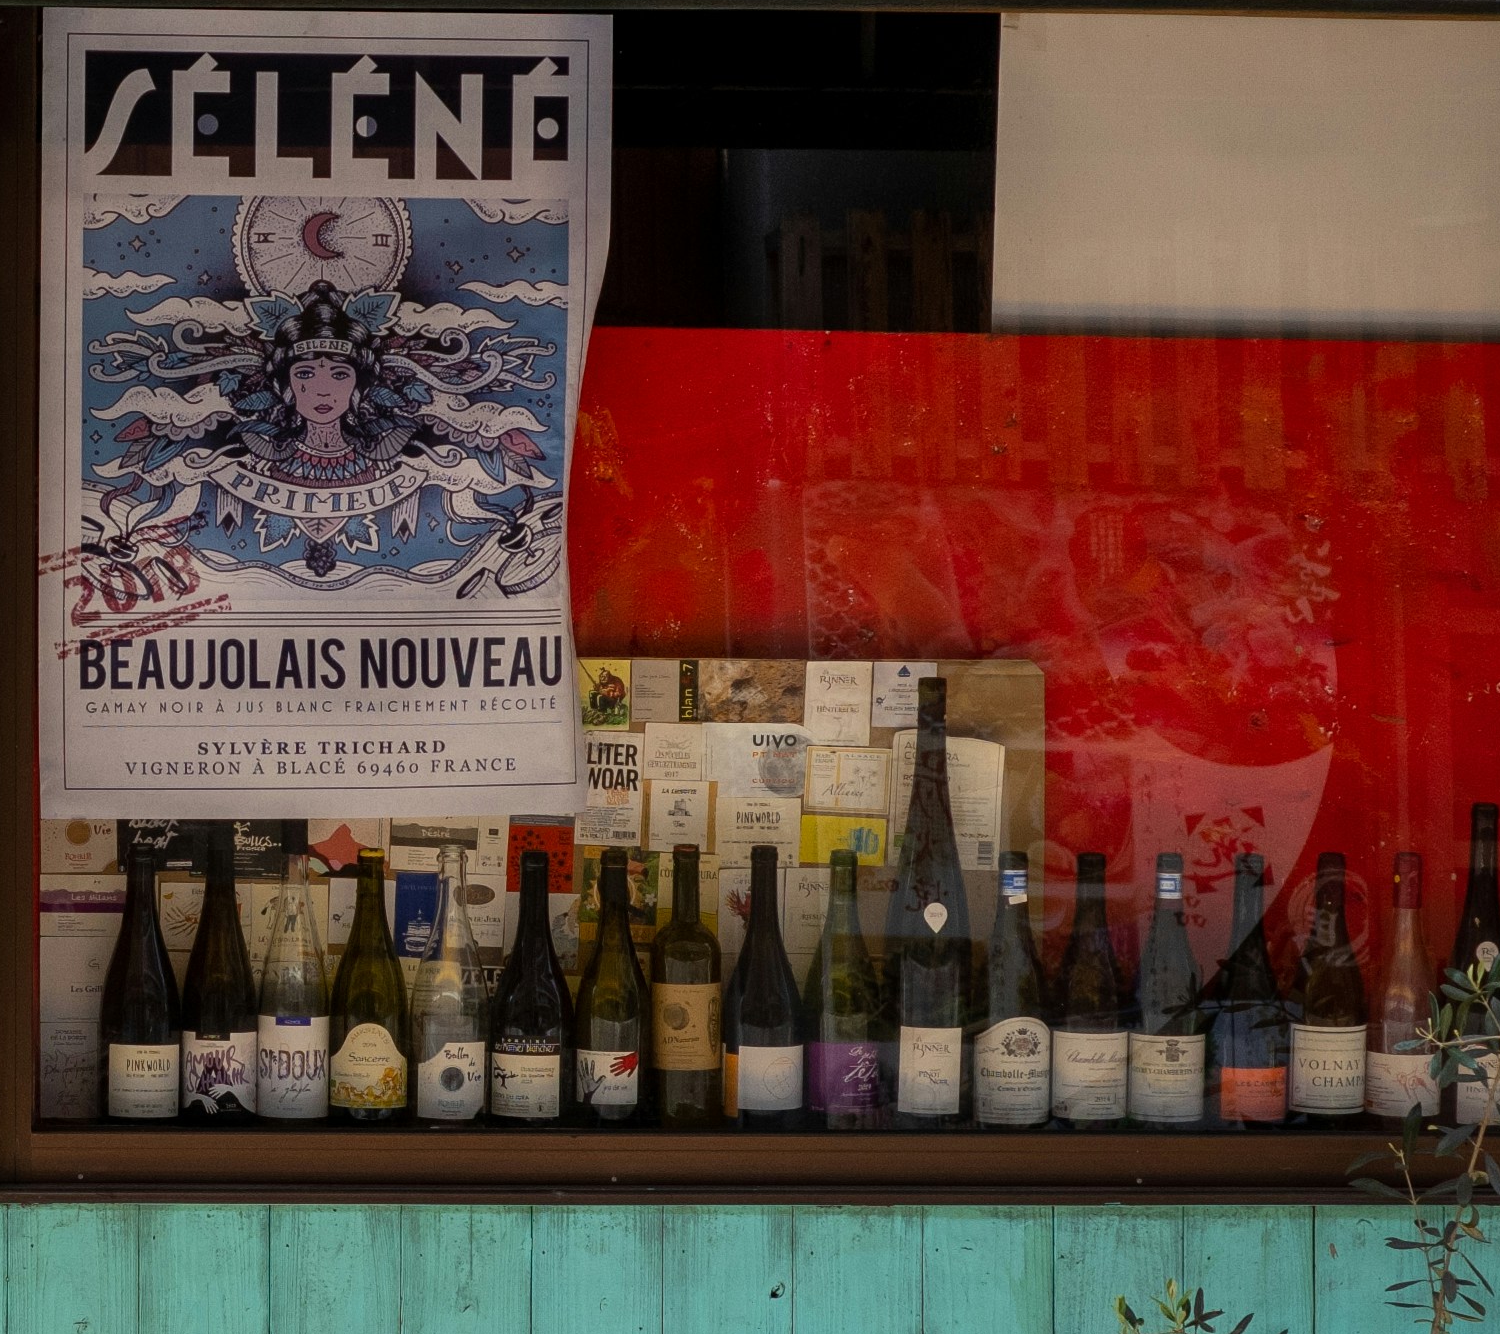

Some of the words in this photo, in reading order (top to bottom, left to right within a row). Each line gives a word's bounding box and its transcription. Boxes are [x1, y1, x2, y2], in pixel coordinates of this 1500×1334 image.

[253, 232, 276, 244] IX
[371, 233, 393, 248] III
[227, 469, 418, 514] PRIMEUR
[79, 638, 347, 690] BEAUJOLAIS
[359, 635, 563, 689] NOUVEAU
[85, 701, 148, 714] GAMAY
[159, 701, 204, 714] NOIR
[215, 698, 225, 713] À
[236, 701, 264, 713] JUS
[276, 700, 333, 713] BLANC
[344, 699, 469, 713] FRAICHEMENT
[480, 695, 557, 711] RÉCOLTÉ
[197, 738, 307, 756] SYLVÈRE
[317, 740, 446, 755] TRICHARD
[752, 734, 797, 748] UIVO
[125, 761, 241, 776] VIGNERON
[252, 758, 265, 775] À
[276, 757, 346, 775] BLACÉ
[357, 761, 419, 777] 69460
[431, 757, 517, 774] FRANCE
[1298, 1058, 1361, 1071] VOLNAY
